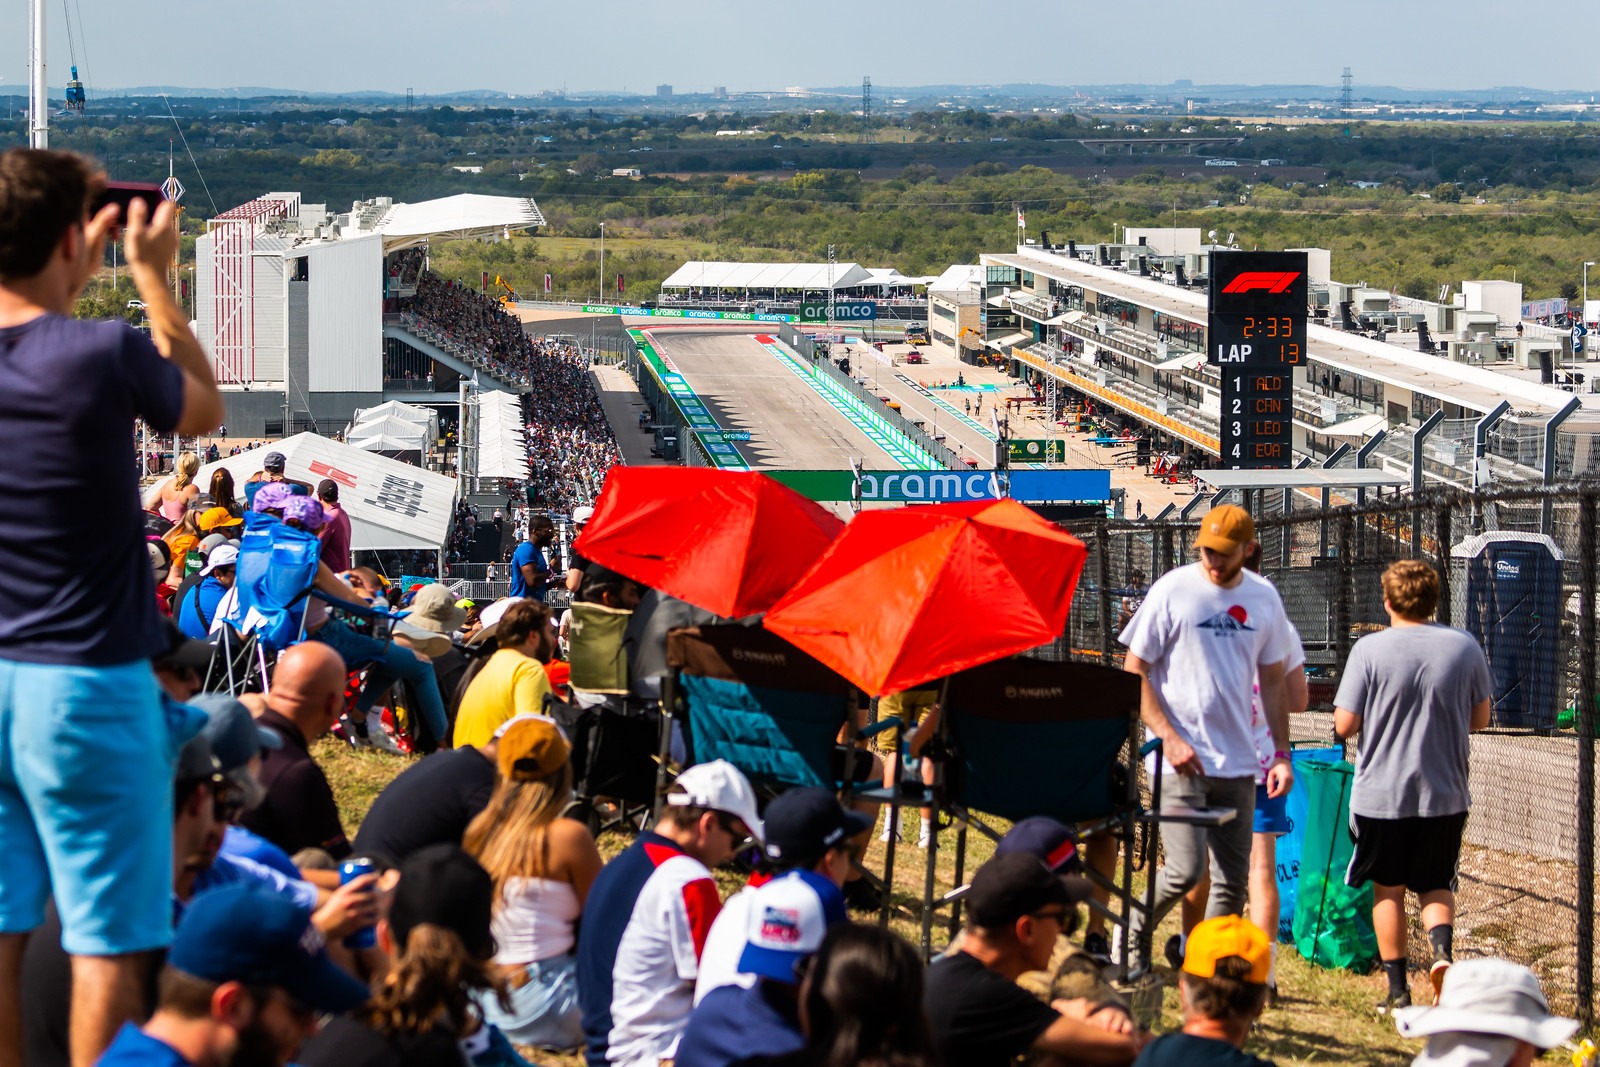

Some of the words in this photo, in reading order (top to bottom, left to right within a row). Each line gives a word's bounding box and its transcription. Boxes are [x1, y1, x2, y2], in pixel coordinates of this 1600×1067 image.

[1221, 271, 1301, 293] F1
[586, 306, 614, 314] aramco
[620, 308, 648, 316] aramco
[689, 311, 717, 319] aramco
[723, 312, 751, 320] aramco
[1243, 317, 1293, 337] 2:33
[1217, 344, 1253, 363] LAP
[1280, 343, 1300, 364] 13
[1233, 376, 1241, 392] 1
[1231, 398, 1242, 414] 2
[1231, 421, 1242, 437] 3
[1255, 421, 1281, 435] LEO
[1231, 443, 1241, 459] 4
